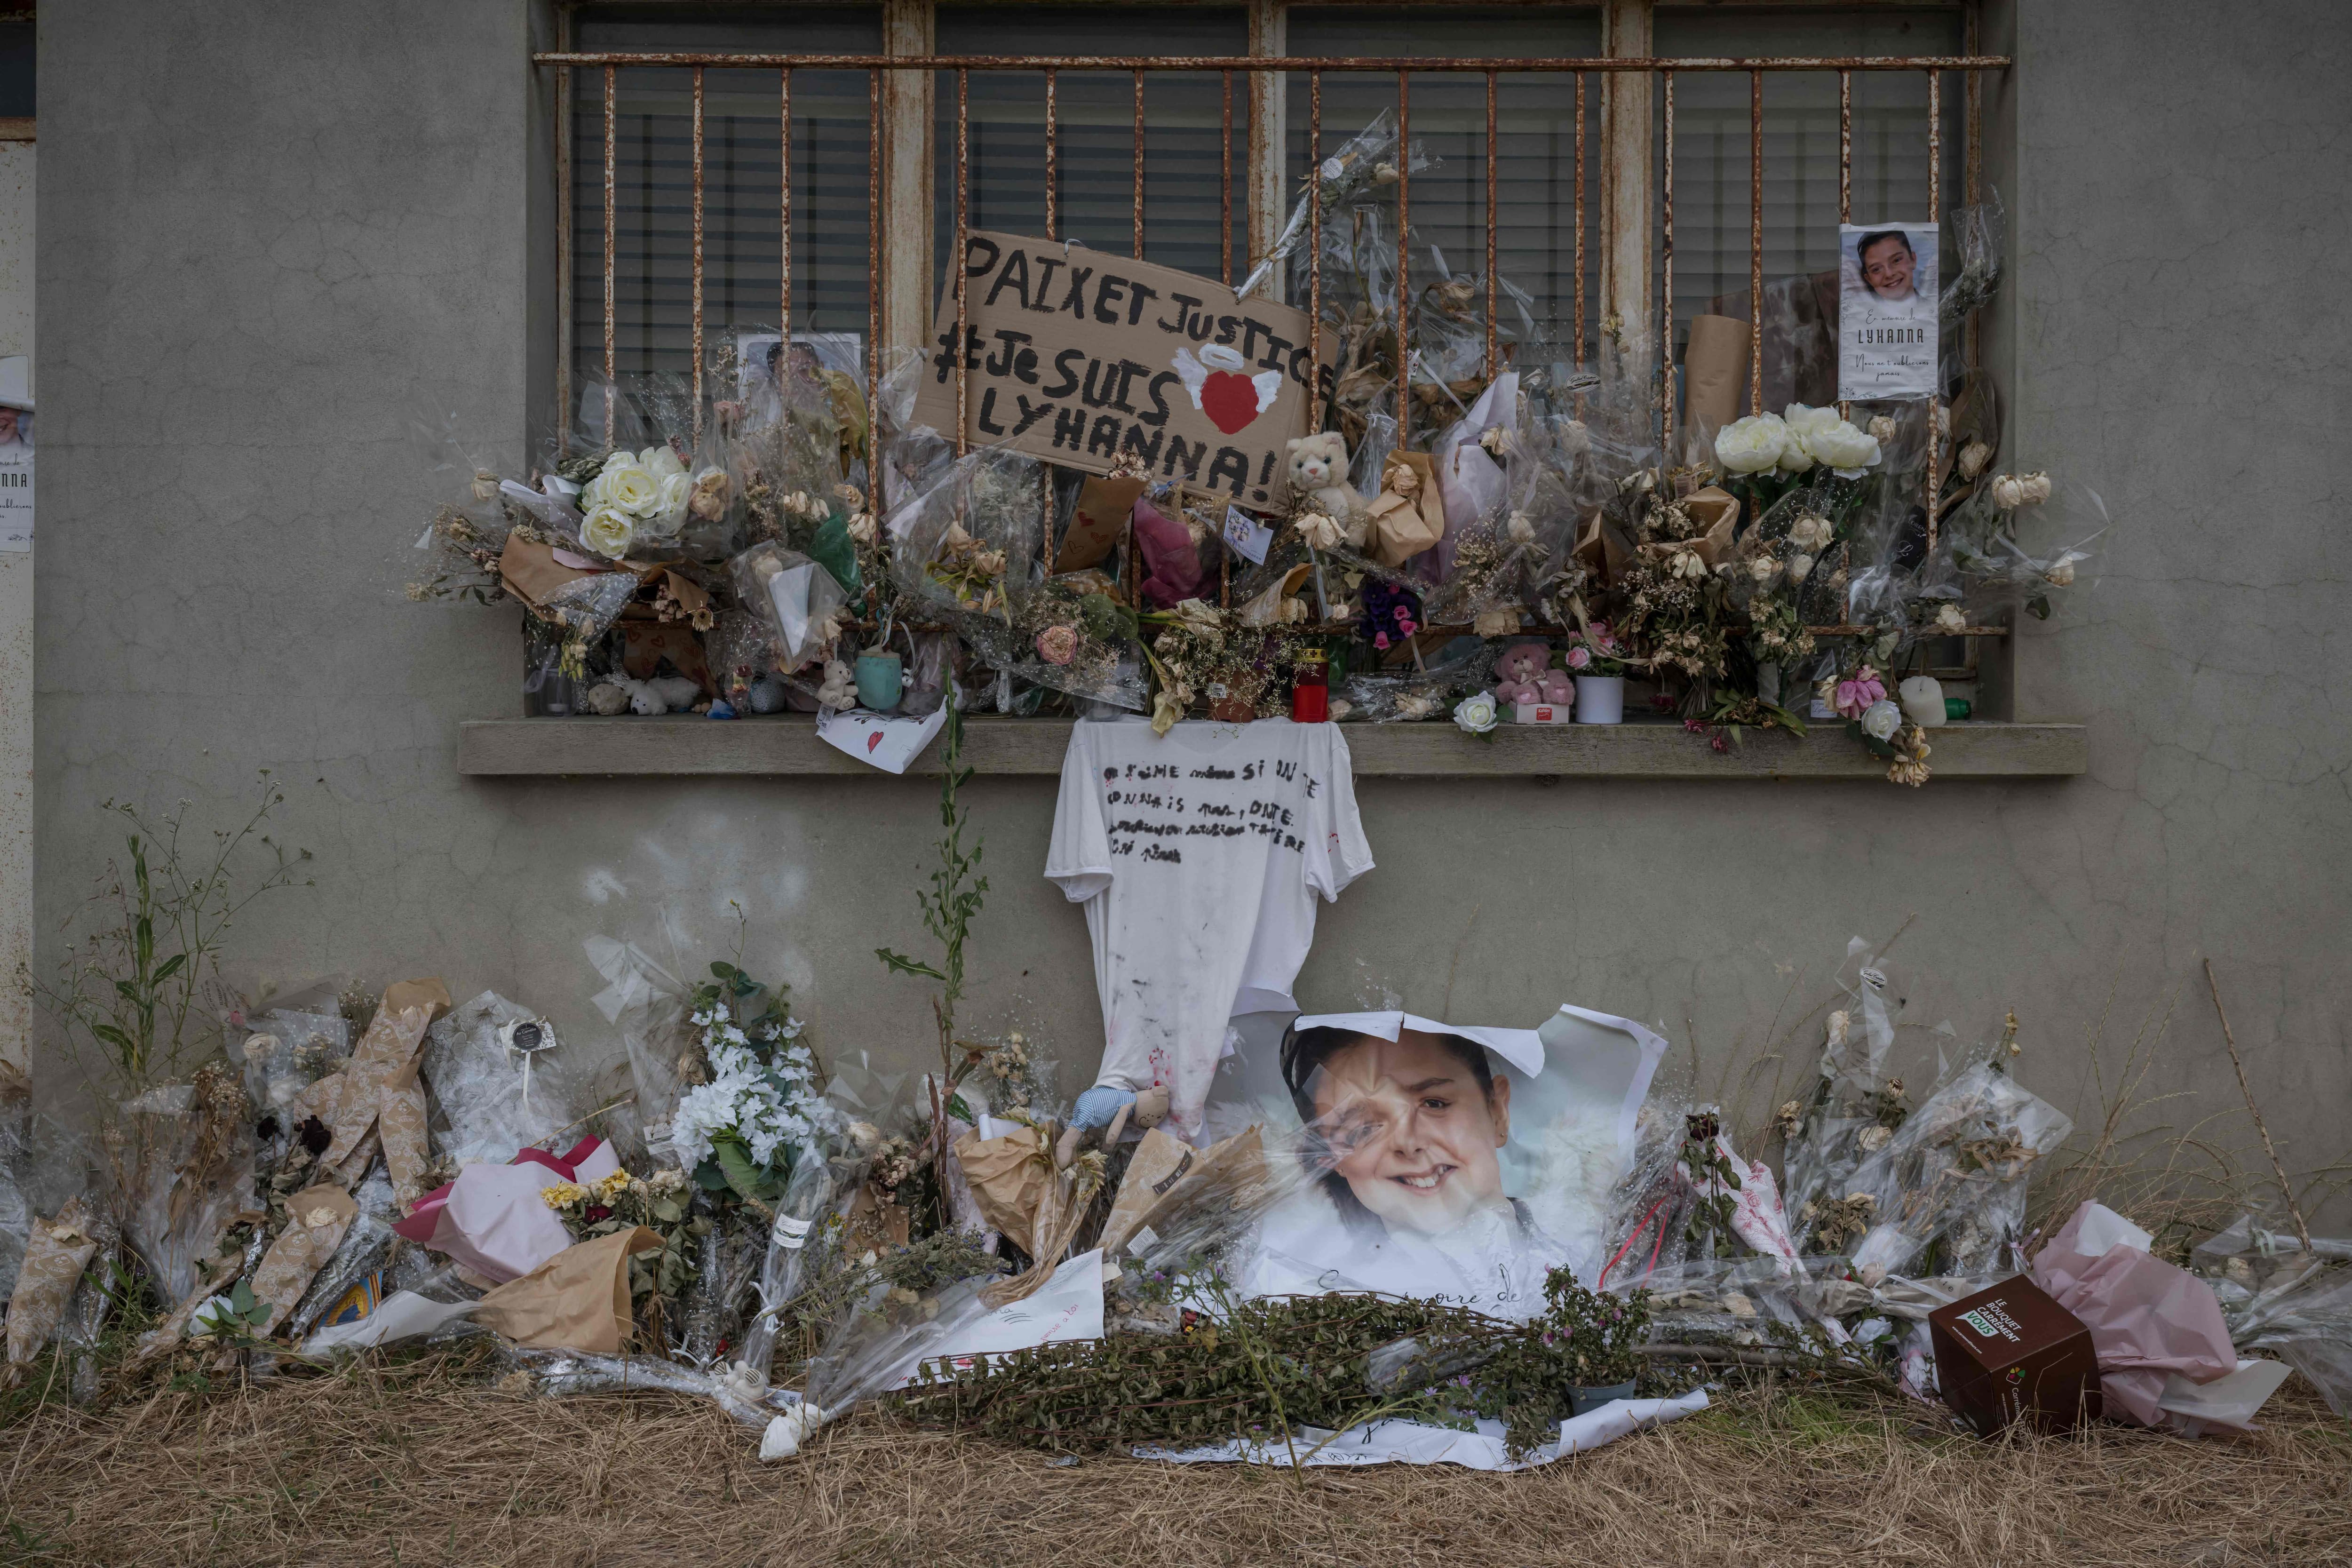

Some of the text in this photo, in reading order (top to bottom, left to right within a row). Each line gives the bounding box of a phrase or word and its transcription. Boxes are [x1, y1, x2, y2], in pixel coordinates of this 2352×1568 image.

[1866, 309, 1878, 325] En
[1909, 307, 1916, 321] de
[1156, 291, 1335, 403] JUSTICE
[1858, 328, 1924, 344] LYHANNA
[1856, 353, 1875, 372] Nous
[978, 387, 1277, 502] LYHANNA!
[1276, 759, 1297, 783] ON
[1994, 1298, 2008, 1307] LE
[1967, 1312, 1994, 1335] VOUS
[1977, 1306, 2021, 1342] CARRÉMENT
[1986, 1302, 2022, 1330] BOUQUET
